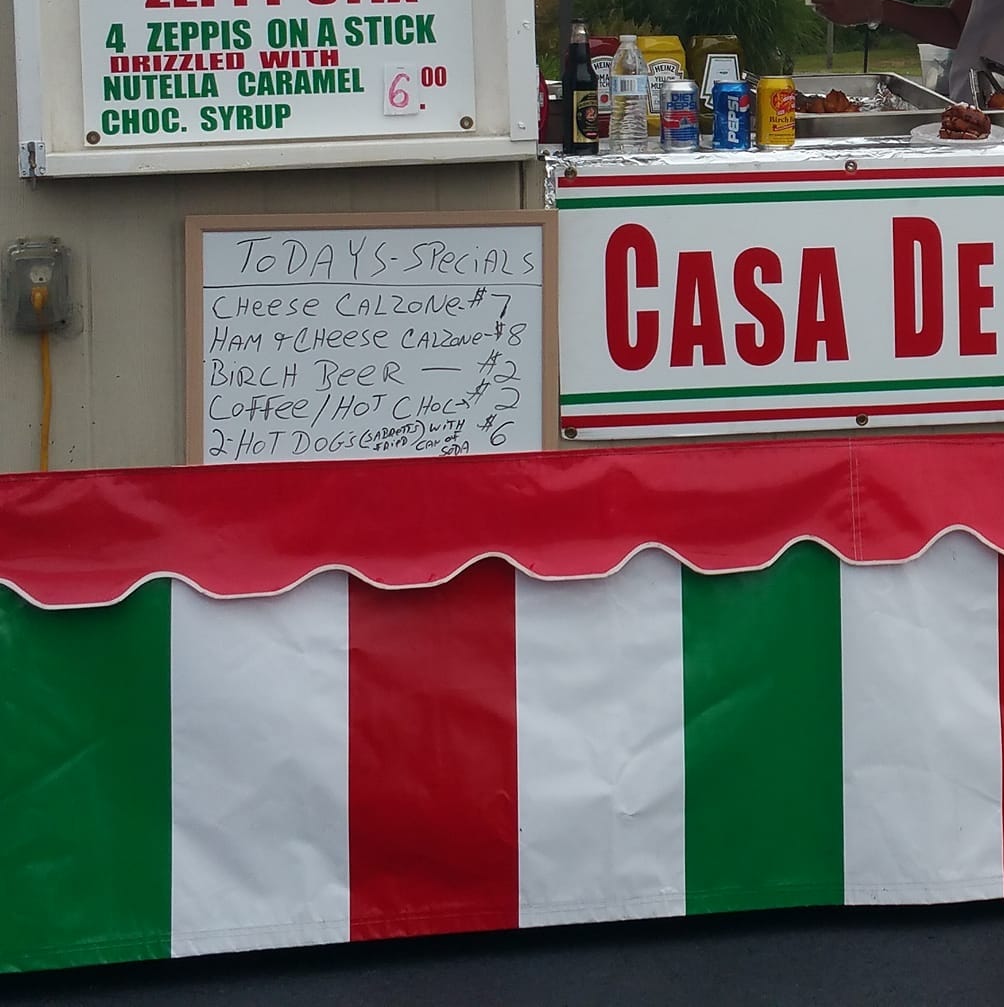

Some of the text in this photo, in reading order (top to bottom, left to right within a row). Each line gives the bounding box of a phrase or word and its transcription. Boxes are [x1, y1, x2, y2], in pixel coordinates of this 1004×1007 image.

[106, 14, 437, 53] 4 ZEPPIS ON A STICK
[110, 49, 340, 74] DRIZZLED WITH
[593, 61, 611, 72] HEIN
[654, 64, 675, 73] HEINZ
[103, 72, 219, 102] NUTELLA
[238, 68, 365, 97] CARAMEL
[671, 93, 695, 102] DIET
[101, 103, 292, 136] CHOC. SYRUP
[727, 95, 740, 144] PEPSI
[209, 326, 263, 353] HAM
